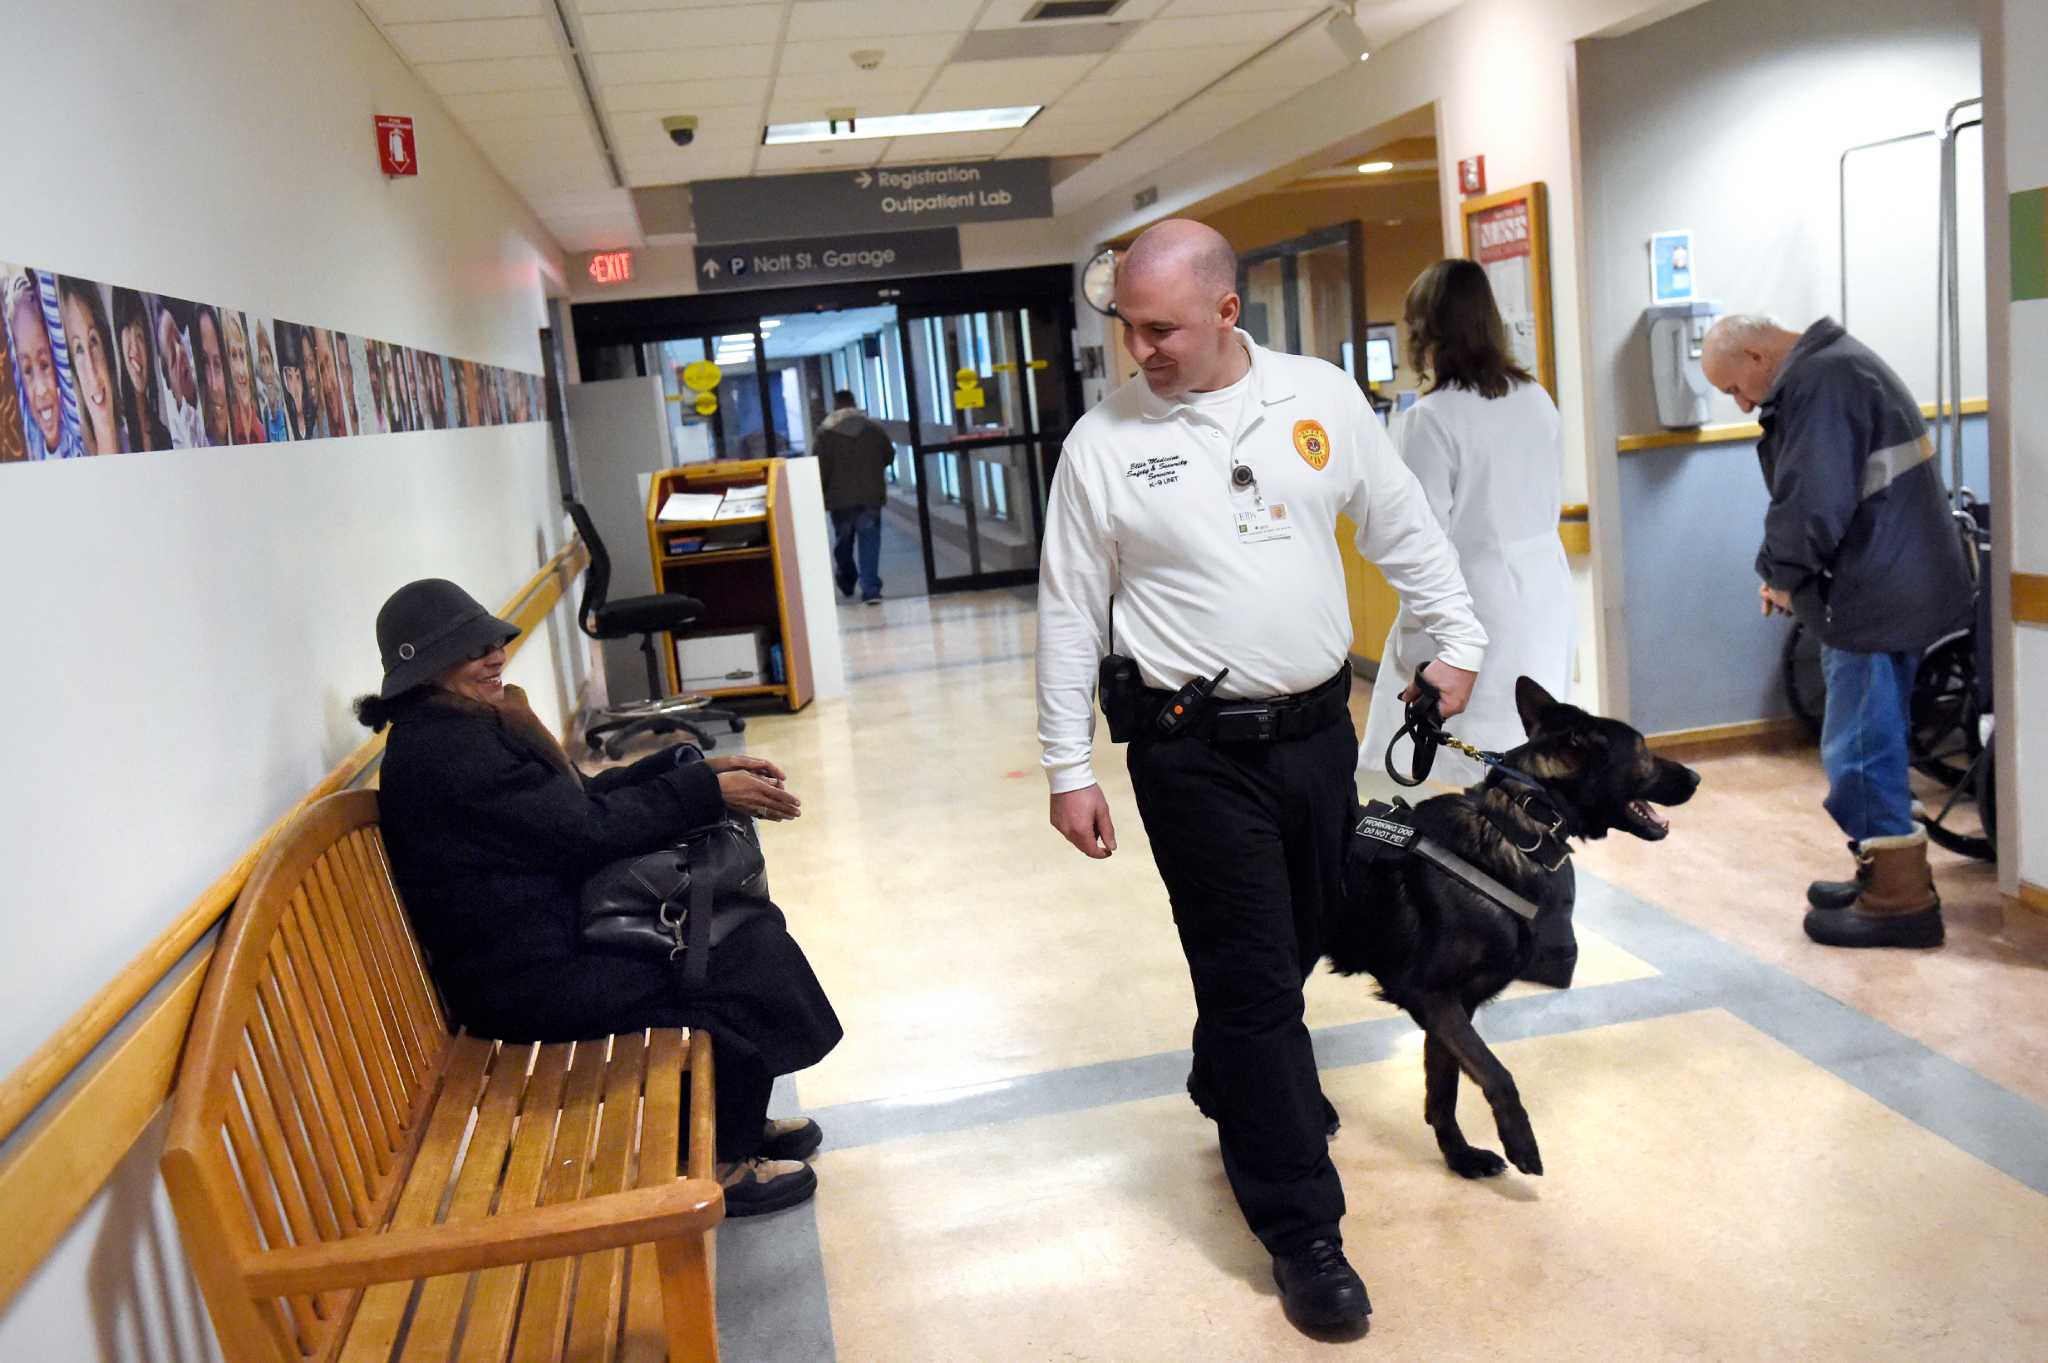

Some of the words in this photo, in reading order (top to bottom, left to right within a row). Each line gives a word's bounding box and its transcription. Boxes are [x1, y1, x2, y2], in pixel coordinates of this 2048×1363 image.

[878, 167, 981, 190] Registration
[881, 192, 975, 214] Outpatient
[979, 190, 1012, 206] Lab
[596, 253, 630, 283] EXIT
[753, 254, 792, 273] Nott
[796, 253, 818, 270] St.
[823, 248, 896, 267] Garage
[1126, 469, 1150, 478] Safety
[1158, 460, 1188, 470] Security
[1148, 455, 1180, 465] Medicine
[1363, 827, 1376, 835] DO
[1375, 829, 1391, 839] NOT
[1390, 833, 1406, 843] PET
[1364, 819, 1398, 832] WORKING
[1397, 827, 1415, 837] DOG
